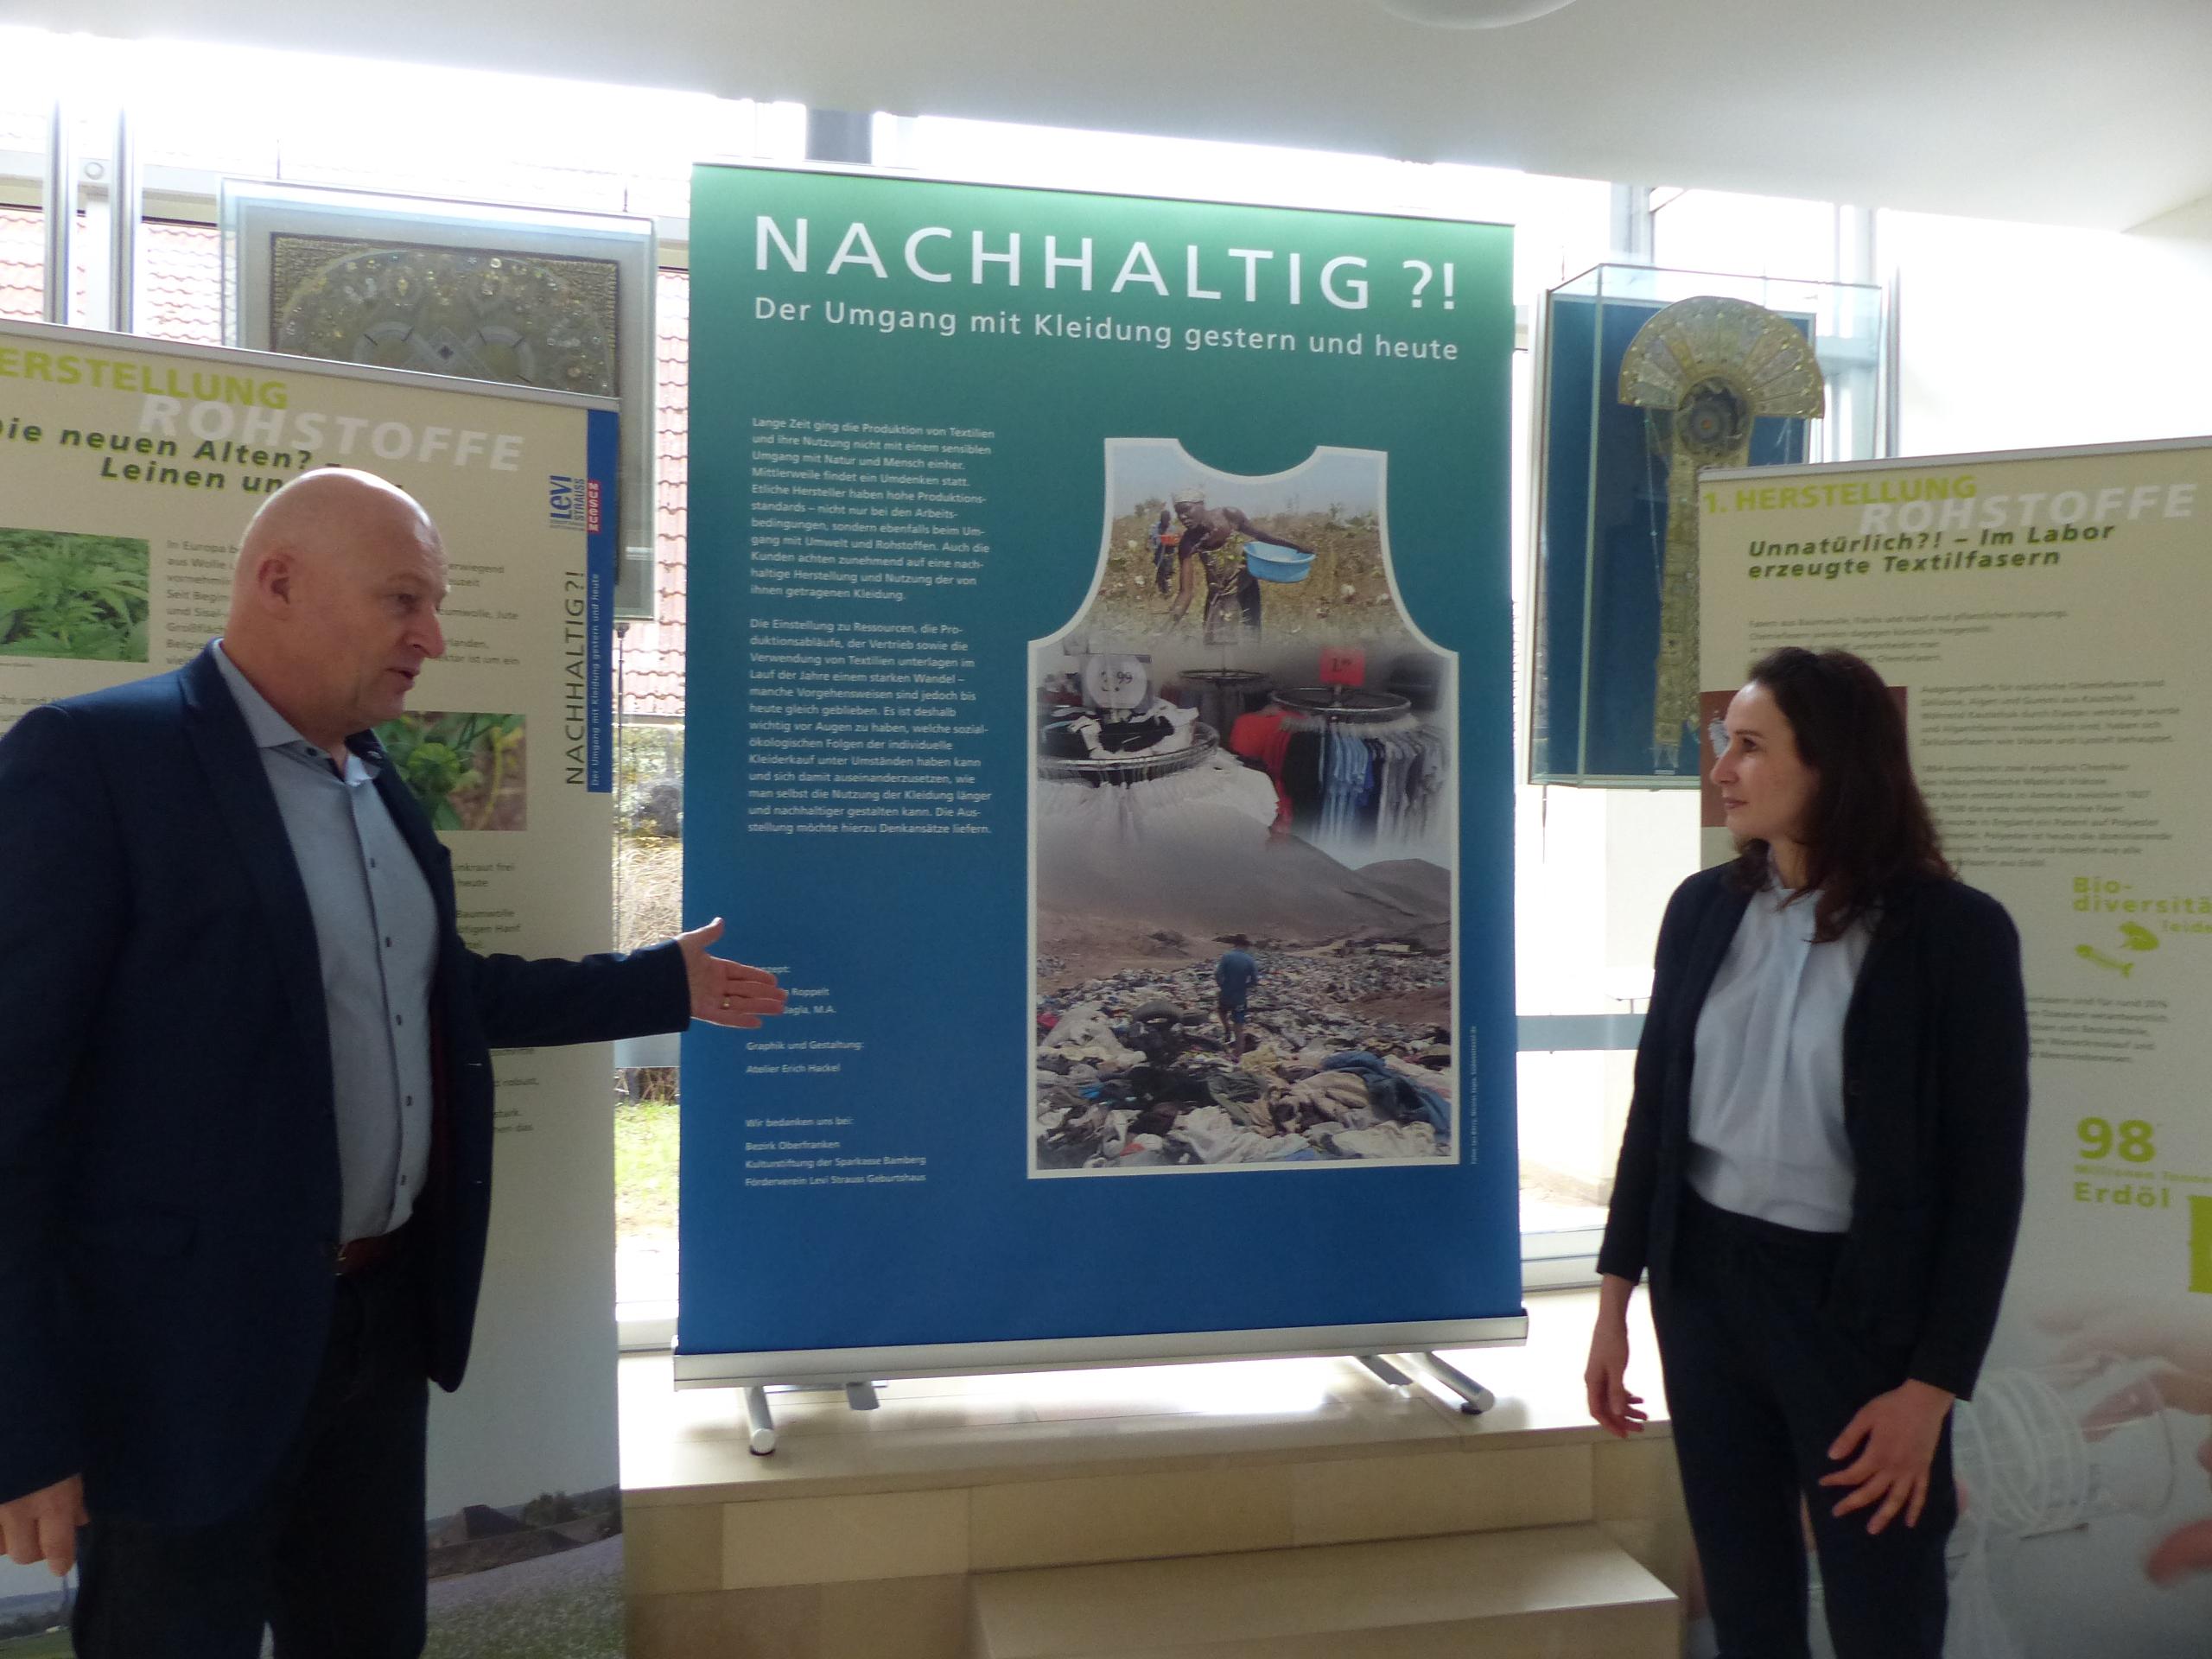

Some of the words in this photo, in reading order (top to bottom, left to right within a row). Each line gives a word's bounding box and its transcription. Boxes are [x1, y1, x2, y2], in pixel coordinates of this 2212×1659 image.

[755, 215, 1370, 309] NACHHALTIG
[1402, 260, 1455, 309] ?!
[755, 296, 810, 321] Der
[825, 300, 956, 336] Umgang
[970, 308, 1021, 334] mit
[1035, 313, 1172, 348] Kleidung
[1184, 325, 1295, 352] gestern
[1309, 333, 1363, 356] und
[1376, 334, 1457, 360] heute
[0, 348, 287, 410] ERSTELLUNG
[138, 394, 525, 472] ROHSTOFFE
[753, 417, 786, 430] Lange
[789, 419, 810, 429] Zeit
[813, 420, 839, 433] ging
[842, 422, 859, 431] die
[861, 423, 923, 435] Produktion
[925, 427, 946, 435] von
[950, 427, 995, 437] Textilien
[0, 417, 42, 442] ie
[60, 428, 177, 456] neuen
[194, 440, 312, 470] Alten?
[753, 435, 774, 444] und
[802, 436, 850, 450] Nutzung
[853, 439, 880, 449] nicht
[884, 441, 902, 450] mit
[905, 442, 939, 452] einem
[941, 443, 991, 454] sensiblen
[752, 451, 799, 465] Umgang
[802, 453, 821, 463] mit
[823, 454, 855, 464] Natur
[859, 455, 880, 466] und
[883, 456, 925, 467] Mensch
[927, 458, 965, 469] einher.
[100, 456, 225, 489] Leinen
[242, 475, 283, 494] un
[823, 470, 856, 481] findet
[859, 472, 877, 482] ein
[880, 473, 938, 485] Umdenken
[942, 475, 969, 486] statt.
[791, 486, 845, 497] Hersteller
[849, 488, 883, 499] haben
[887, 490, 914, 500] hohe
[917, 491, 987, 503] Produktions-
[1702, 492, 1728, 513] 1.
[1735, 474, 1978, 512] HERSTELLUNG
[817, 504, 845, 514] nicht
[849, 506, 868, 515] nur
[890, 506, 912, 517] den
[914, 507, 957, 518] Arbeits-
[1859, 483, 2197, 536] ROHSTOFFE
[751, 518, 828, 532] bedingungen,
[831, 521, 876, 531] sondern
[880, 523, 930, 533] ebenfalls
[931, 524, 959, 535] beim
[1749, 531, 1943, 558] Unnatürlich?!
[1980, 527, 2015, 548] Im
[2027, 522, 2116, 544] Labor
[751, 537, 779, 548] gang
[783, 536, 802, 546] mit
[804, 537, 849, 548] Umwelt
[850, 538, 873, 549] und
[874, 539, 939, 550] Rohstoffen.
[942, 542, 969, 552] Auch
[972, 543, 990, 553] die
[751, 551, 794, 562] Kunden
[798, 553, 836, 563] achten
[838, 555, 904, 566] zunehmend
[906, 557, 925, 567] auf
[927, 558, 951, 568] eine
[953, 559, 983, 569] nach-
[1747, 557, 1871, 580] erzeugte
[1884, 549, 2061, 575] Textilfasern
[591, 573, 600, 601] heute
[793, 569, 857, 583] Herstellung
[861, 572, 882, 582] und
[885, 573, 933, 586] Nutzung
[935, 575, 954, 584] der
[750, 585, 783, 595] ihnen
[785, 587, 850, 601] getragenen
[852, 589, 906, 603] Kleidung.
[591, 603, 600, 621] und
[591, 625, 601, 658] gestern
[564, 570, 584, 785] NACHHALTIG?!
[591, 664, 601, 706] Kleidung
[591, 709, 600, 725] mit
[591, 728, 601, 766] Umgang
[591, 772, 600, 786] Der
[2074, 876, 2133, 893] Bio-
[2074, 895, 2212, 914] diversitä
[2077, 1117, 2157, 1163] 98
[2075, 1181, 2171, 1209] Erdöl
